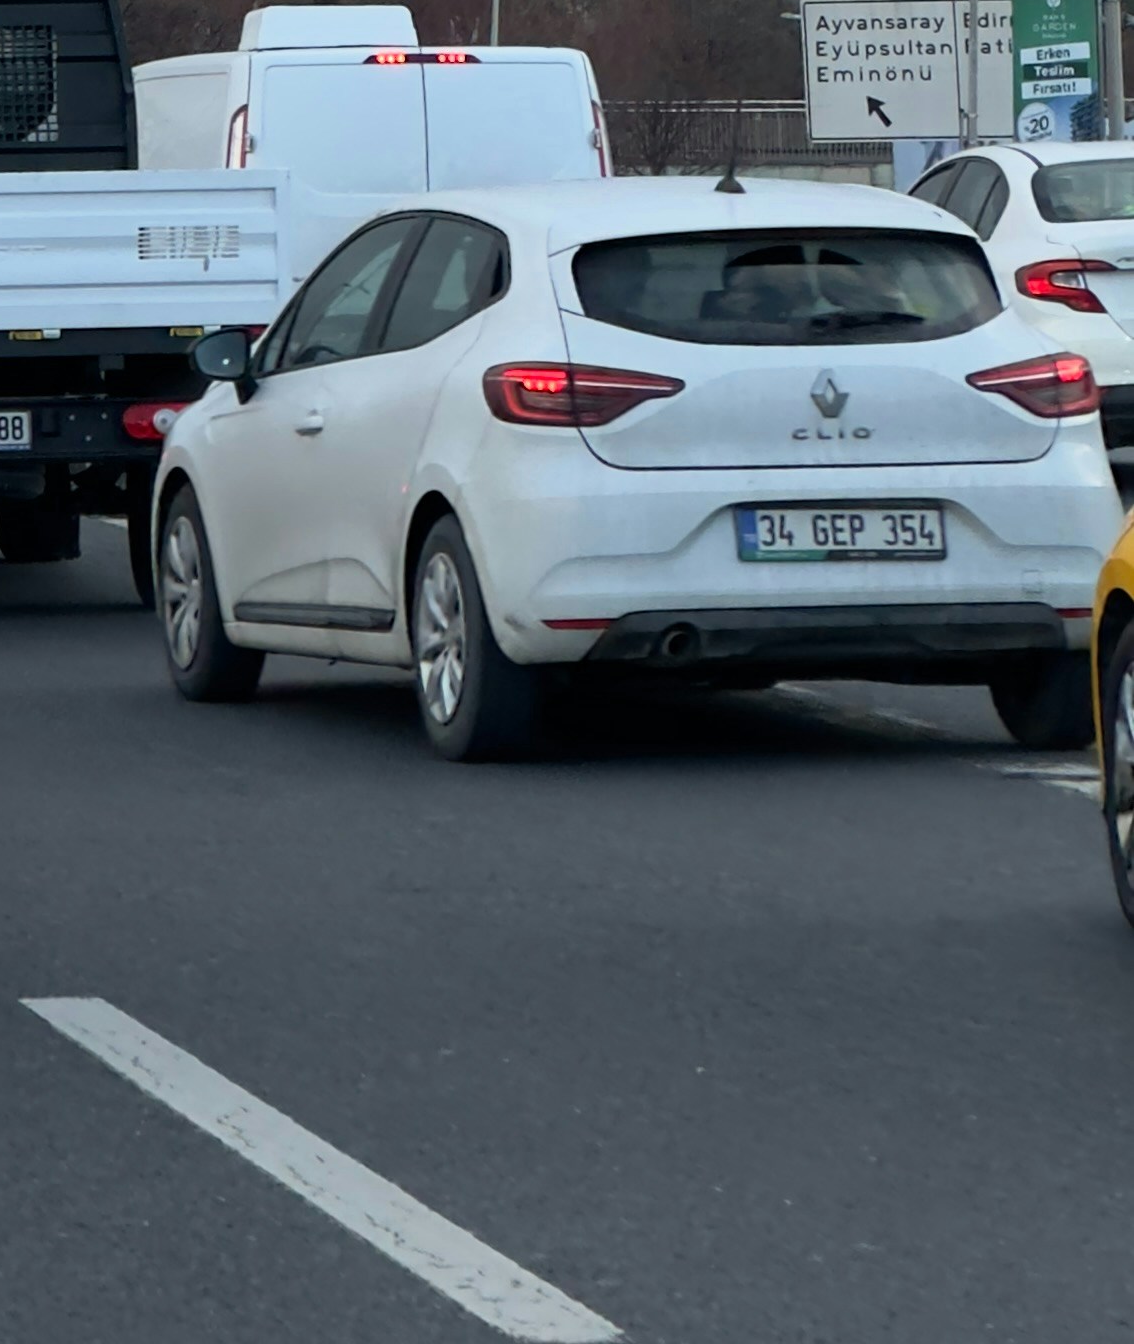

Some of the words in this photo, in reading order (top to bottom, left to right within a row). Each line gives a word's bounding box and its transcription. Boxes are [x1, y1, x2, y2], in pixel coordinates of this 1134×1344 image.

[816, 15, 945, 35] Ayvansaray
[816, 39, 953, 61] Eyüpsultan
[1036, 48, 1071, 61] Erken
[817, 65, 932, 83] Eminönü
[1034, 64, 1075, 77] Teslim
[792, 427, 872, 440] CLIO
[759, 514, 794, 546] 34
[812, 514, 865, 546] GEP
[881, 514, 935, 546] 354
